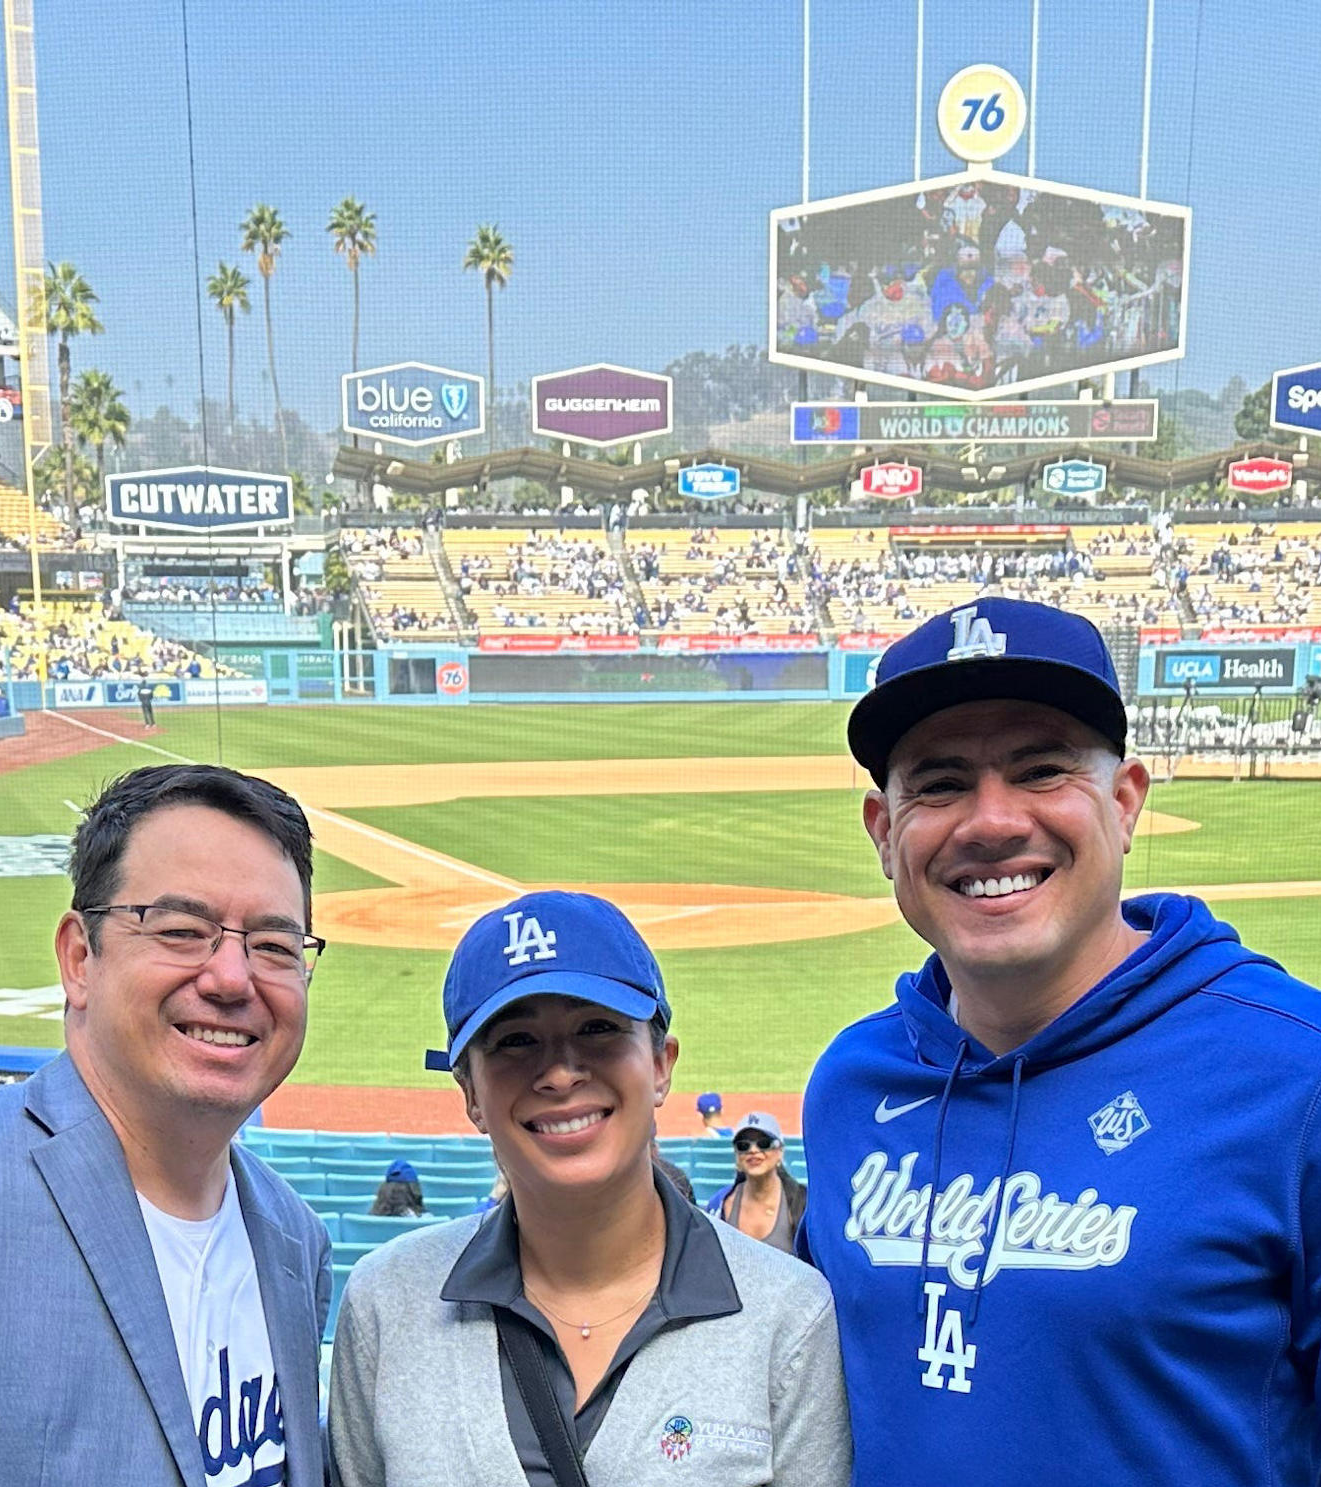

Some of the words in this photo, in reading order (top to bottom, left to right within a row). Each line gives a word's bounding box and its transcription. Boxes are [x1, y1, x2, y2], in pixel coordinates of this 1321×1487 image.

[961, 93, 1005, 132] 76
[358, 379, 433, 412] blue
[544, 397, 661, 412] GUGGENHEIM
[370, 412, 442, 428] california
[879, 416, 942, 438] WORLD
[966, 415, 1070, 438] CHAMPIONS
[120, 483, 278, 515] CUTWATER
[948, 605, 1007, 661] LA
[442, 671, 462, 686] 76
[1172, 662, 1213, 678] UCLA
[1223, 658, 1284, 679] Health
[502, 911, 557, 966] LA
[844, 1151, 1000, 1243] World
[975, 1171, 1138, 1276] Series
[918, 1281, 977, 1394] LA
